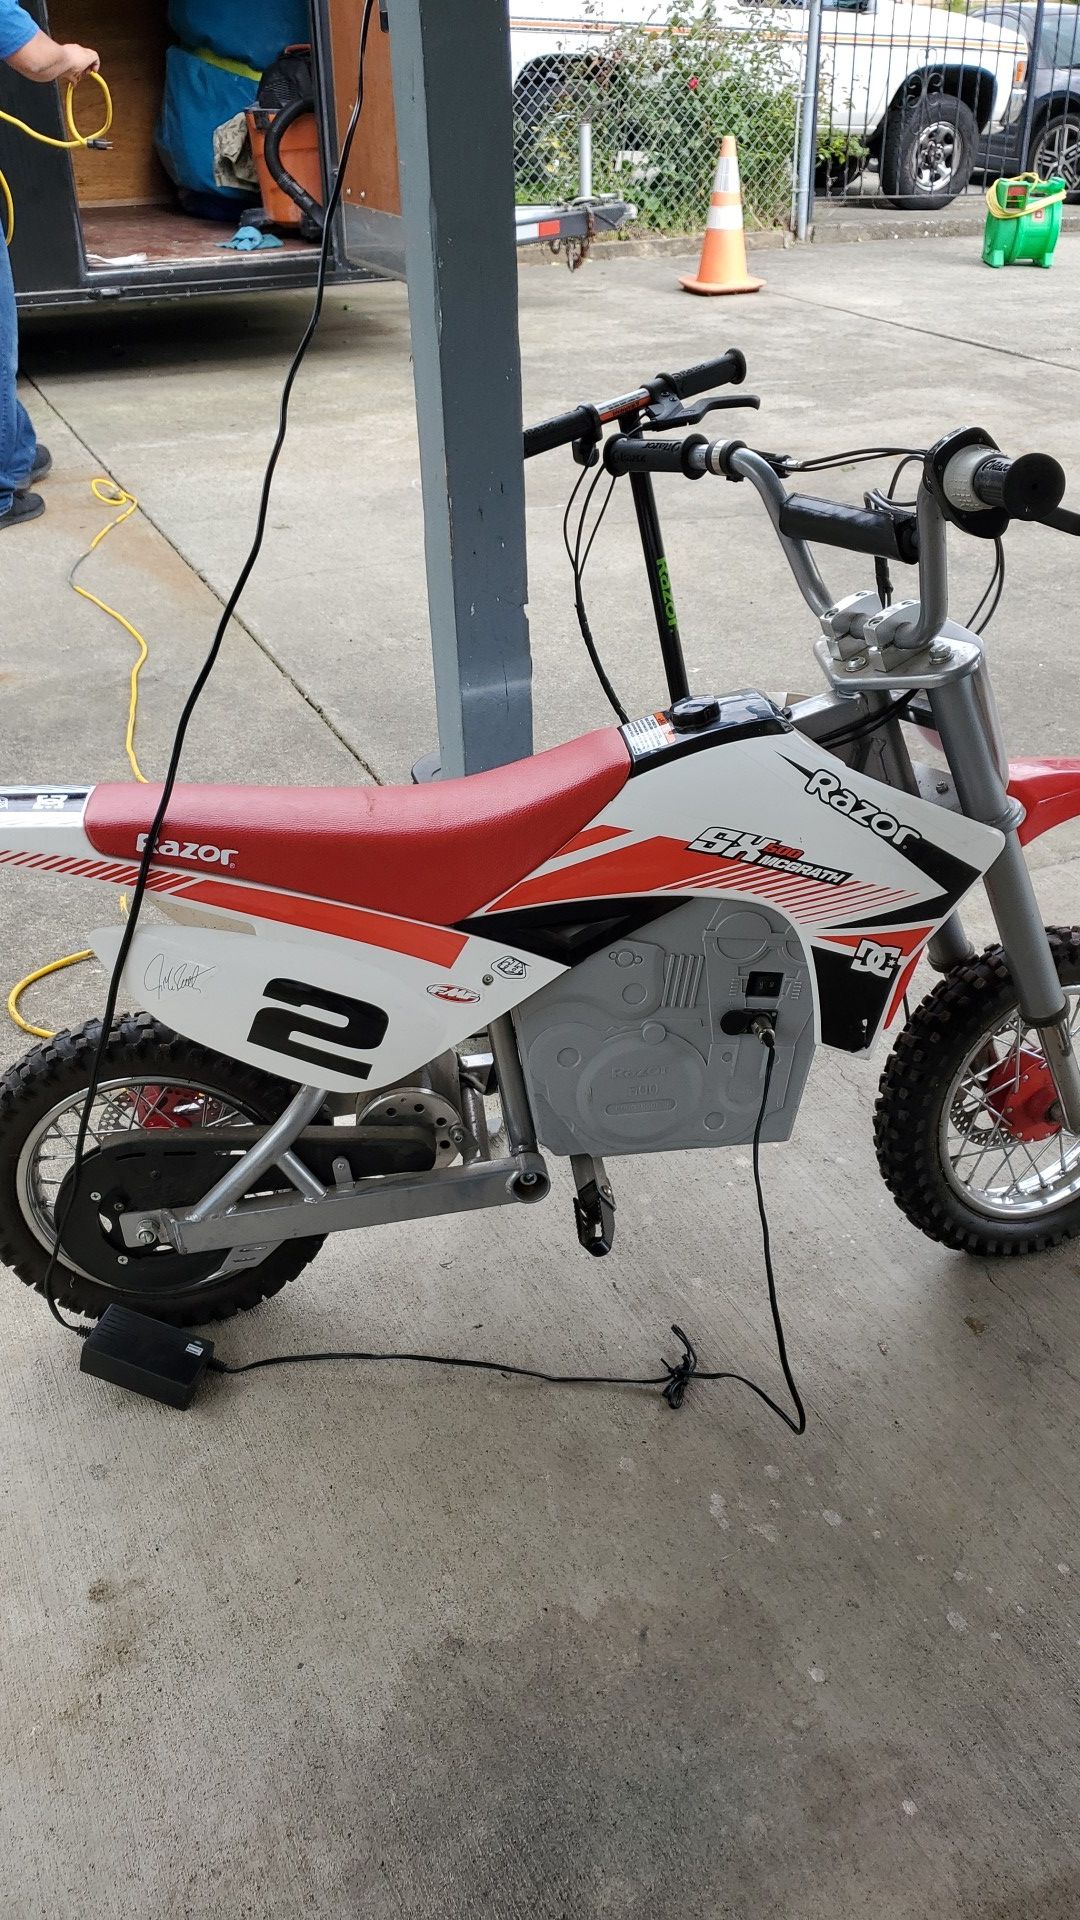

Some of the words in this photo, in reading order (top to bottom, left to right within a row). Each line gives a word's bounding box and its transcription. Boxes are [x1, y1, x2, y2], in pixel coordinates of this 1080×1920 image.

[656, 556, 678, 627] Razor
[804, 768, 922, 846] Razor
[136, 833, 239, 866] Razor
[686, 827, 781, 862] SX
[758, 855, 846, 883] MCGRATH
[851, 940, 901, 978] DC
[247, 978, 389, 1080] 2
